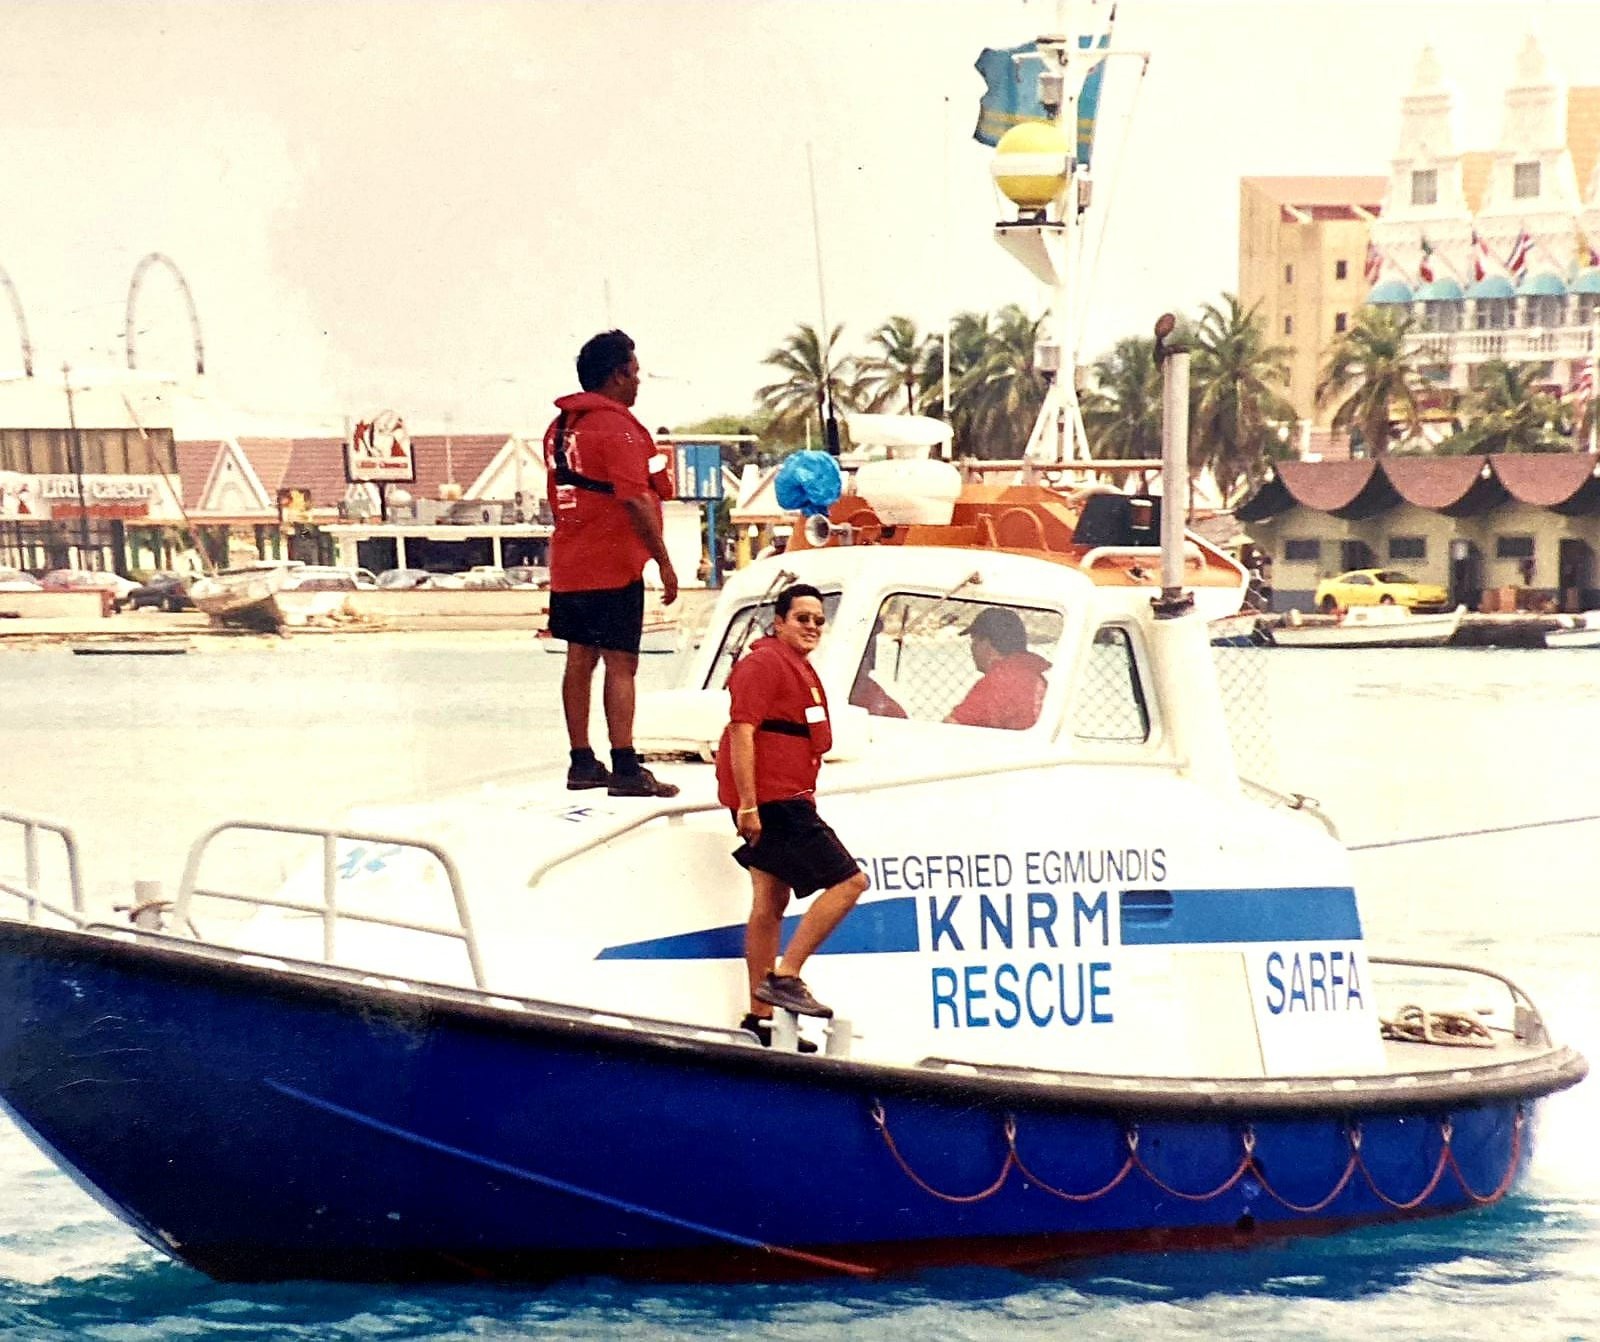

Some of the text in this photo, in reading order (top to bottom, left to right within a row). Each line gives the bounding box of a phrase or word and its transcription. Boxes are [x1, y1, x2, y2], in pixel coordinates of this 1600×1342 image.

[854, 849, 1168, 892] SIEGFRIED EGMUNDIS
[930, 891, 1110, 953] KNRM
[932, 962, 1115, 1031] RESCUE
[1266, 951, 1364, 1016] SARFA
